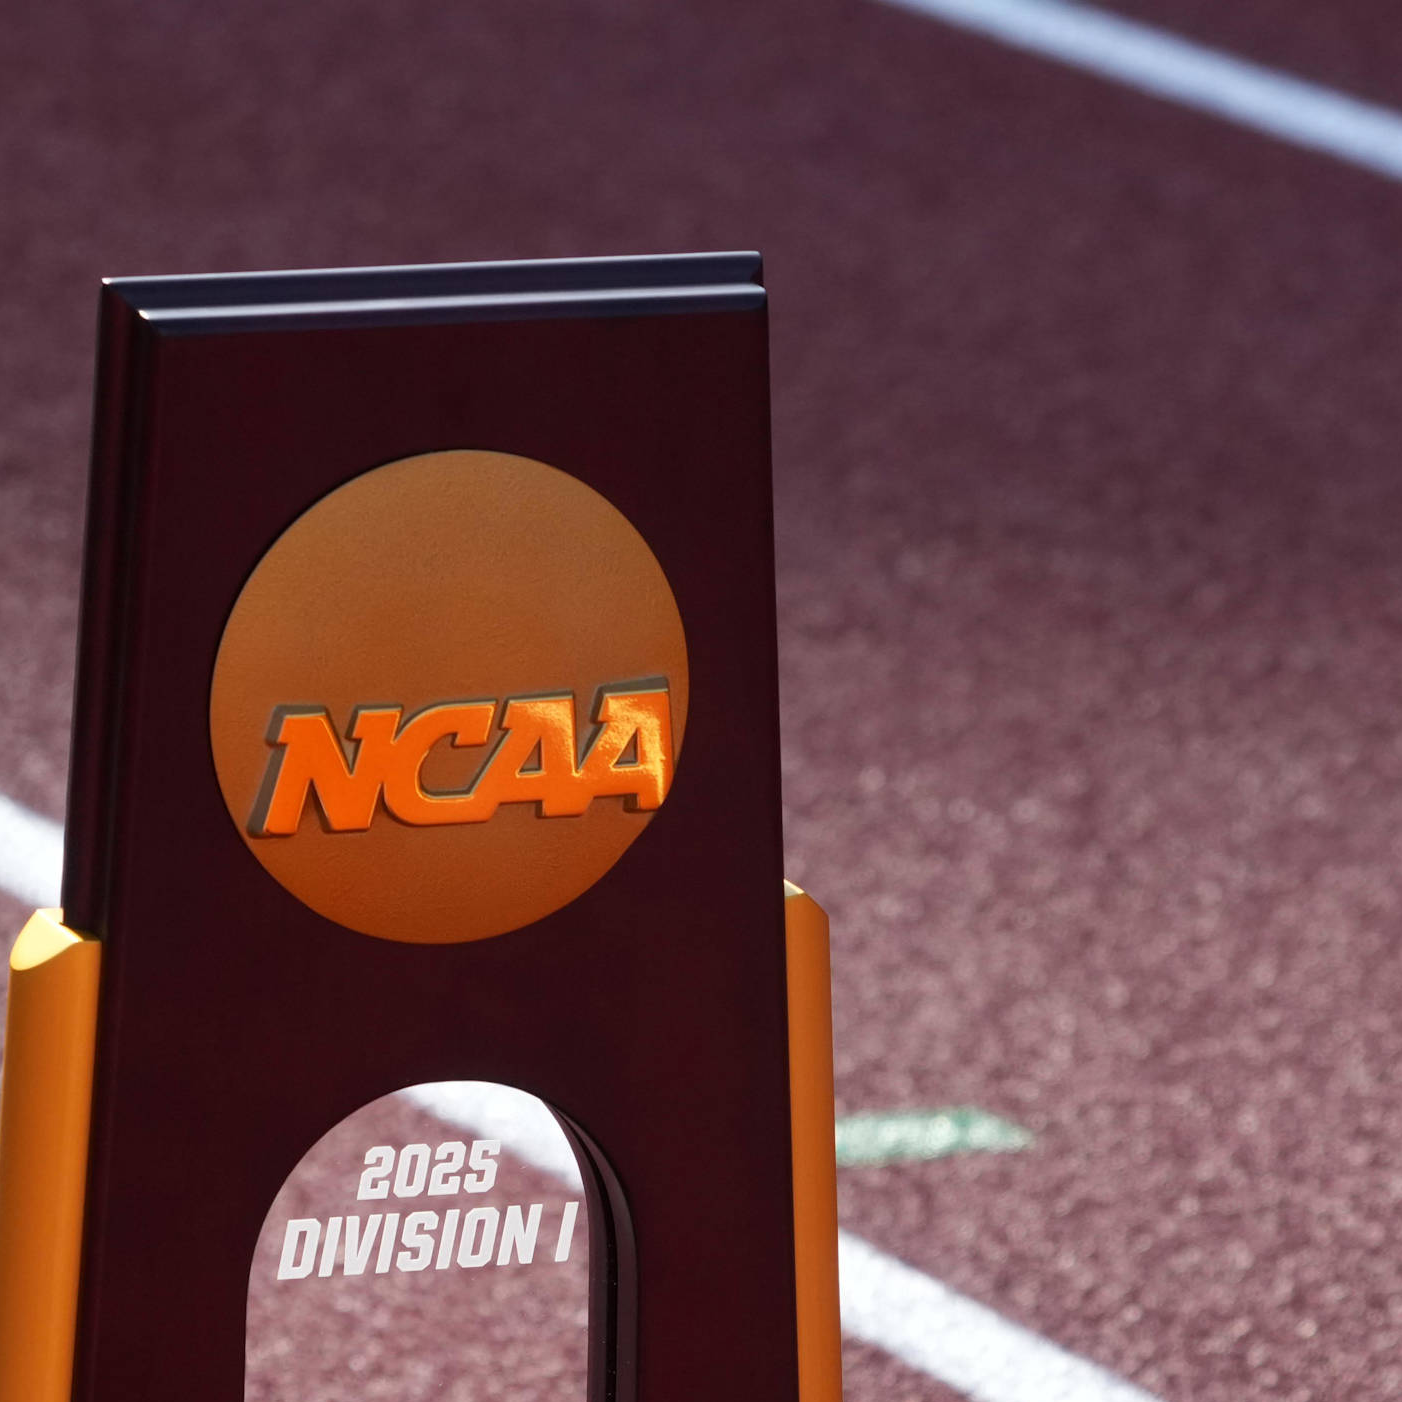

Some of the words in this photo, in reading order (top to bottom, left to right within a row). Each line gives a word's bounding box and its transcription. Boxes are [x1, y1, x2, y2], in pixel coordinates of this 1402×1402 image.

[247, 676, 674, 838] NCAA
[357, 1140, 500, 1200] 2025
[277, 1204, 543, 1280] DIVISION
[554, 1201, 579, 1262] I
